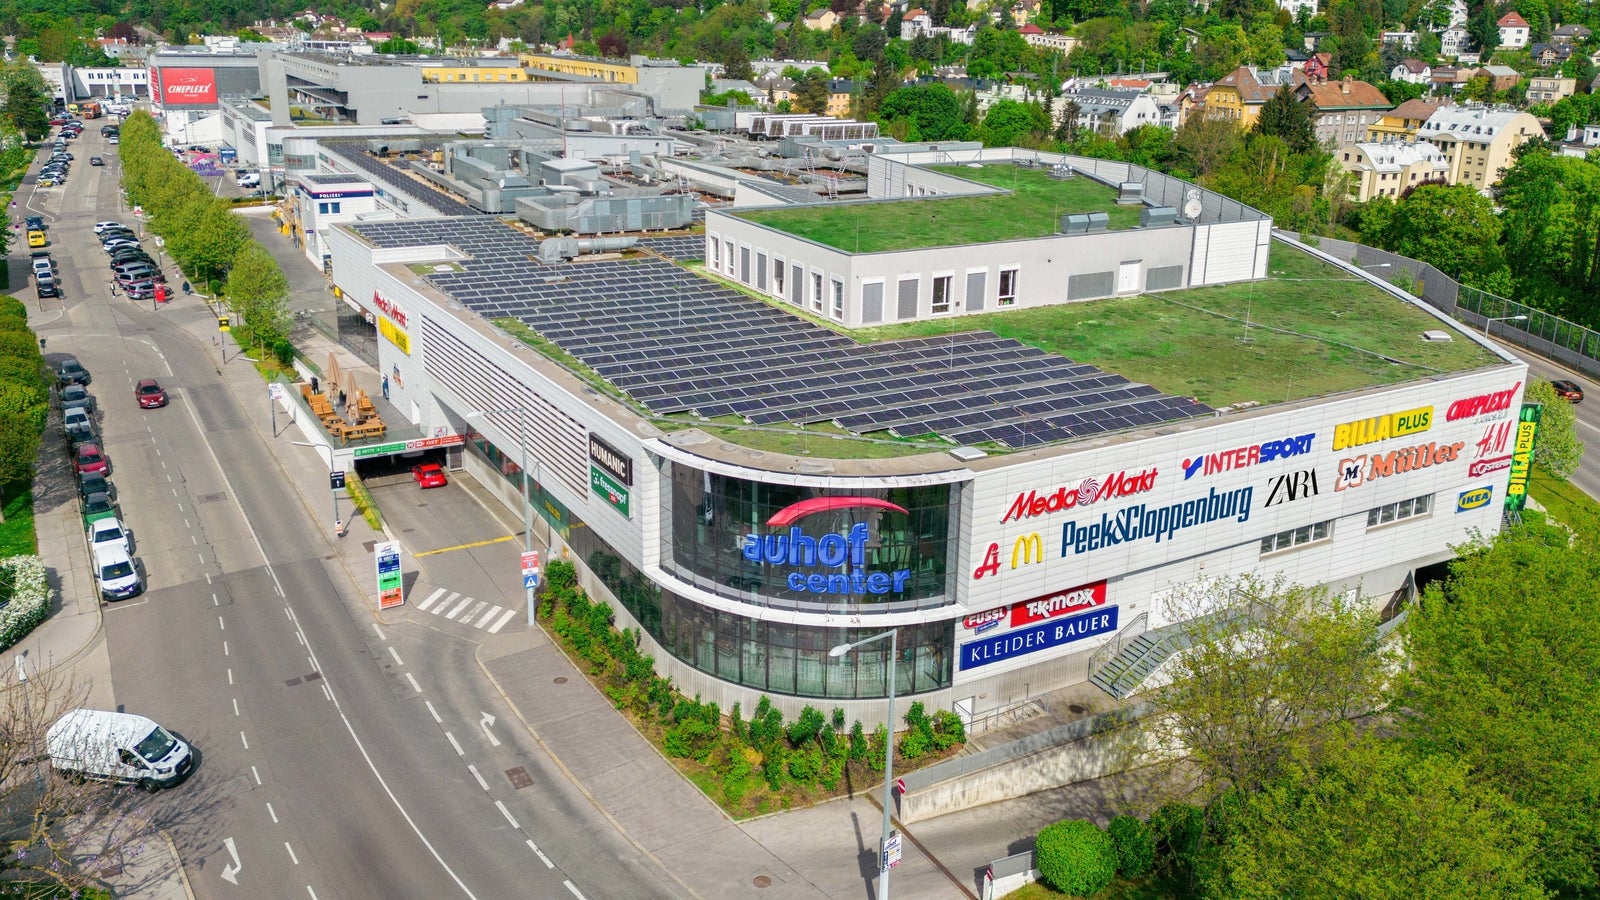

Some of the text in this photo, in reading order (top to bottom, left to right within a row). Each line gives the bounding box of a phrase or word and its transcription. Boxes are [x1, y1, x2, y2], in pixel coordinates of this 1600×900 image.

[168, 83, 212, 94] CINEPLEXX
[1446, 381, 1522, 423] CINEPLEXX
[1332, 412, 1430, 451] BILLA PLUS
[1474, 420, 1513, 459] H&M
[590, 440, 626, 478] HUMANIC
[1203, 432, 1316, 477] INTERSPORT
[1367, 441, 1466, 481] Müller
[1508, 424, 1532, 495] BILLA PLUS
[599, 476, 627, 505] fressnapf
[1264, 467, 1320, 508] ZARA
[1461, 492, 1490, 506] IKEA
[742, 521, 870, 567] auhof
[787, 568, 911, 595] center
[968, 607, 1005, 626] FUSSL
[971, 614, 1110, 662] KLEIDER BAUER
